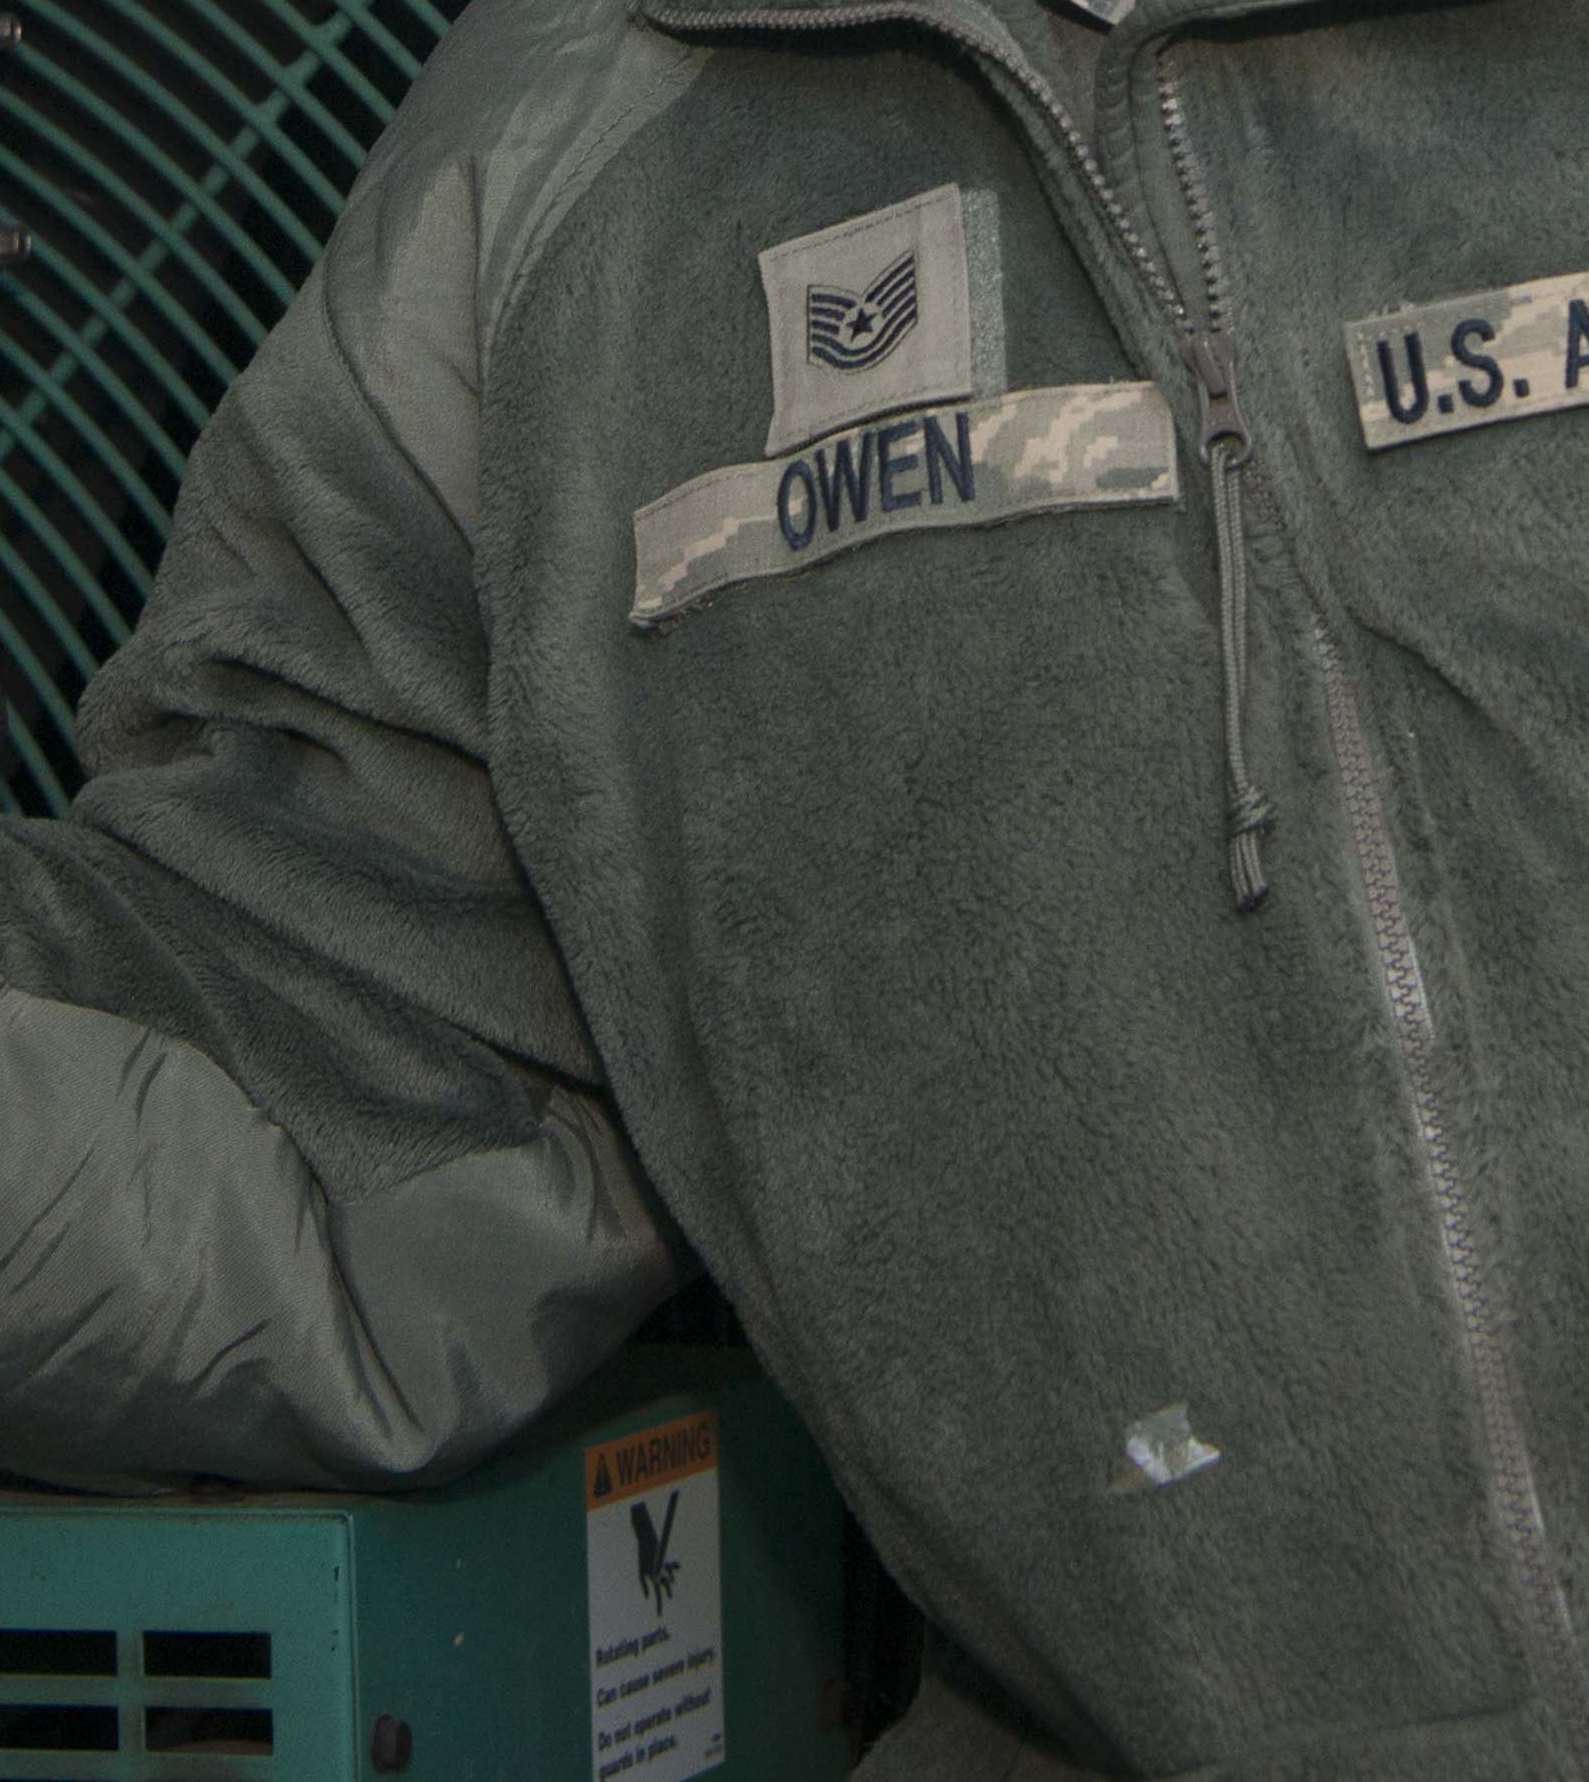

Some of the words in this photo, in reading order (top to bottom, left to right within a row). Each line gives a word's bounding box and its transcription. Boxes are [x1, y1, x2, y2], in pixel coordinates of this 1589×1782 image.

[1377, 318, 1529, 424] U.S.
[776, 410, 974, 551] OWEN
[616, 1421, 710, 1486] WARNING
[596, 1638, 639, 1667] Rotating
[597, 1687, 617, 1707] Can
[619, 1673, 650, 1698] cause
[652, 1659, 684, 1684] severe
[598, 1731, 611, 1751] Do
[614, 1721, 631, 1743] not
[634, 1707, 671, 1735] operate
[674, 1687, 711, 1717] without
[599, 1750, 634, 1782] guards
[635, 1745, 646, 1764] in
